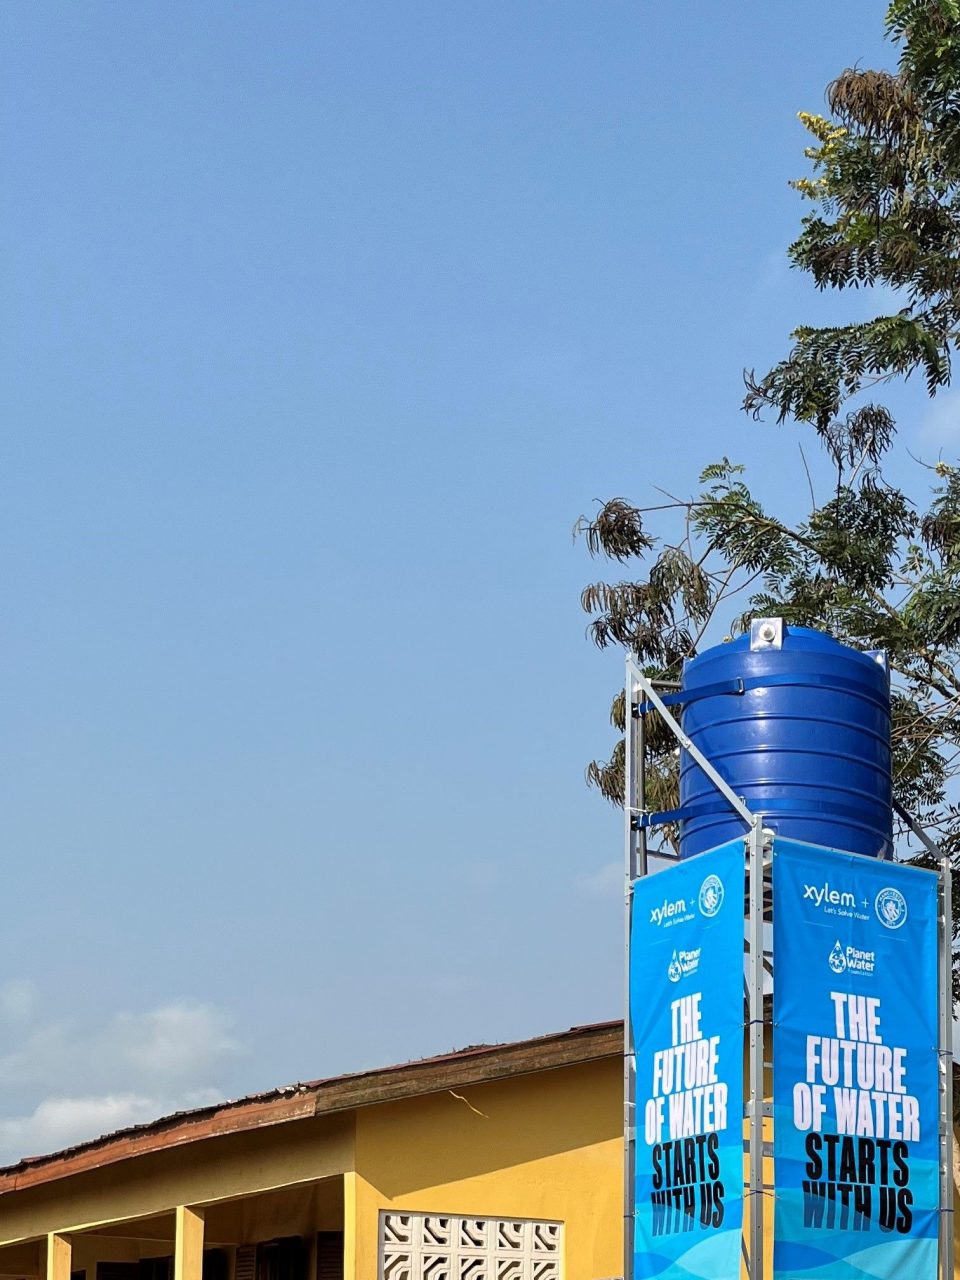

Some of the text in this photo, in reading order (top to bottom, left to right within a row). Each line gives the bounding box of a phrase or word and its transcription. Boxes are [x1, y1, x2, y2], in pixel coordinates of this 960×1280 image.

[649, 899, 687, 926] xylem
[803, 882, 856, 907] xylem
[824, 906, 870, 920] Let's Solve Water
[679, 947, 701, 960] Planet
[680, 958, 700, 973] Water
[846, 946, 875, 961] Planet
[846, 957, 875, 972] Water
[671, 992, 702, 1047] THE
[830, 991, 882, 1044] THE
[652, 1035, 720, 1098] FUTURE
[806, 1035, 907, 1094] FUTURE
[644, 1082, 728, 1146] OF WATER
[793, 1081, 920, 1142] OF WATER
[652, 1133, 720, 1190] STARTS
[805, 1131, 909, 1187] STARTS
[651, 1181, 725, 1237] WITH US
[802, 1180, 913, 1235] WITH US
